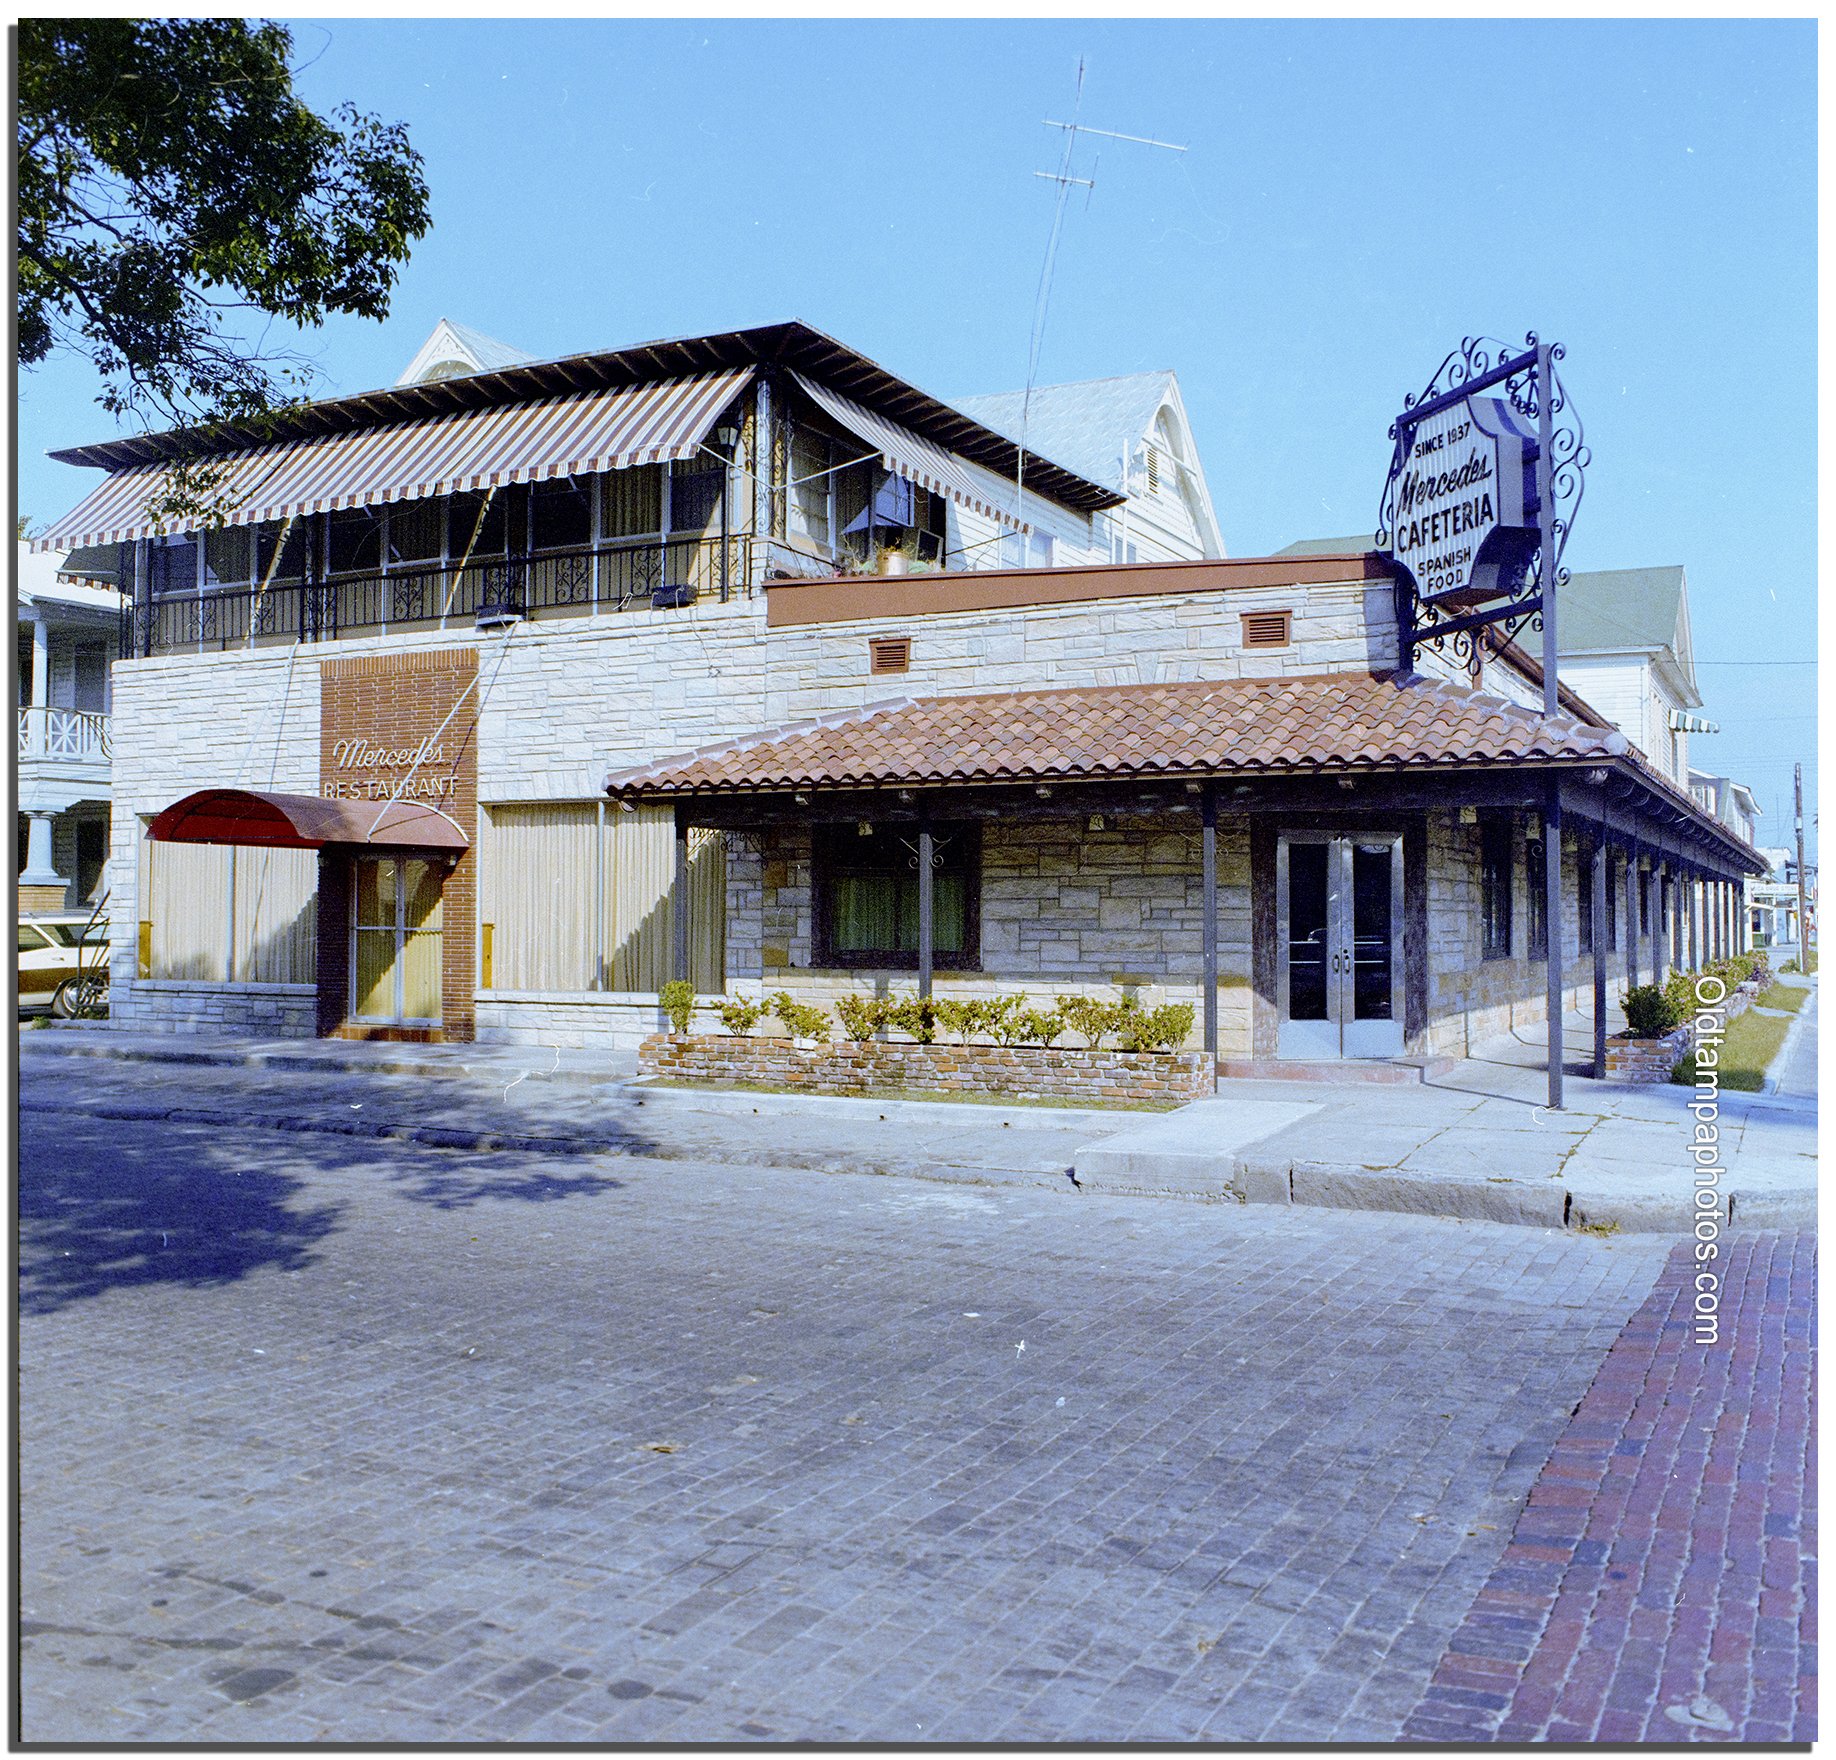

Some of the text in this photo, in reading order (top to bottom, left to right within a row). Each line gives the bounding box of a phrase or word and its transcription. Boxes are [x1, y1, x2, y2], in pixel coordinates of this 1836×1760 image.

[1415, 421, 1471, 459] SINCE 1937
[1396, 446, 1493, 520] Mercedes
[1398, 493, 1494, 553] CAFETERIA
[1417, 546, 1471, 577] SPANISH
[1427, 569, 1463, 594] FOOD
[332, 736, 446, 768] Mercedes
[324, 776, 459, 800] RESTAURANT
